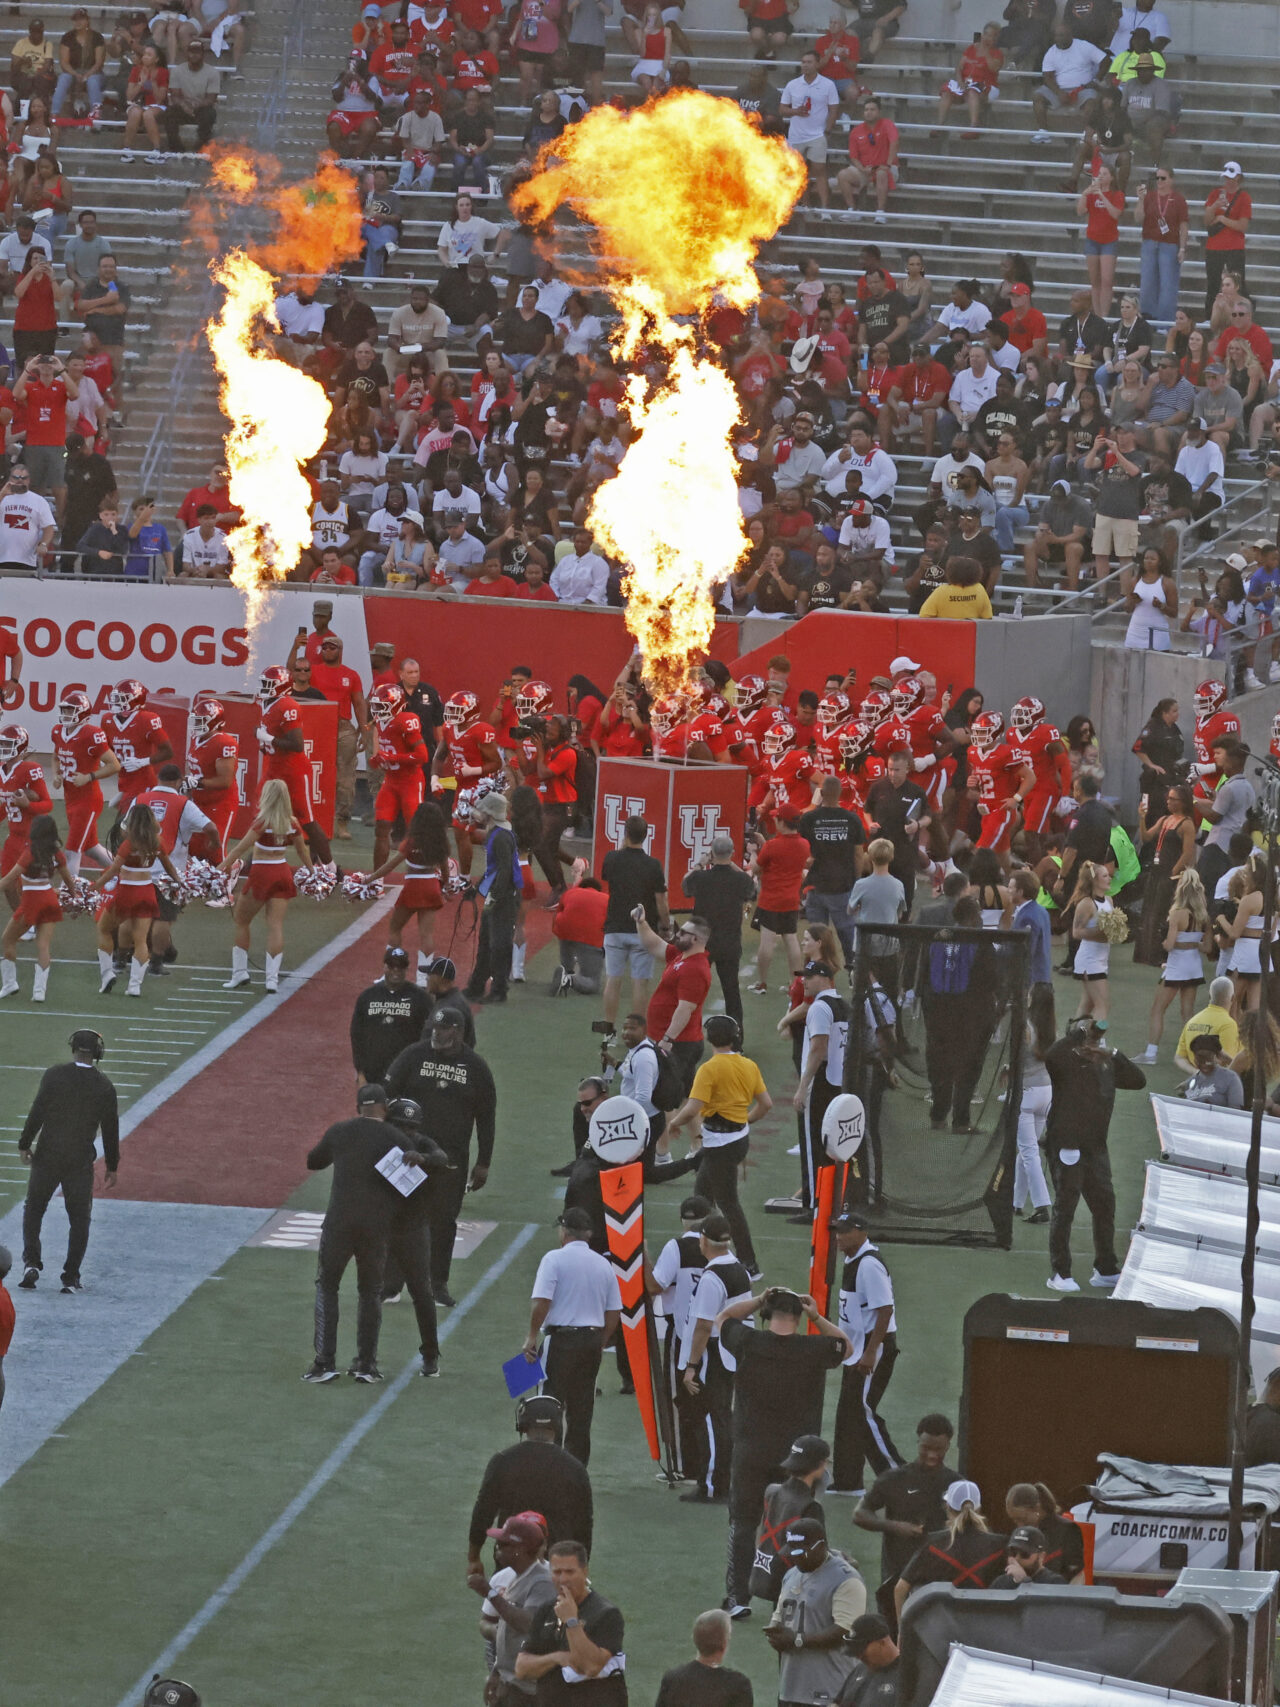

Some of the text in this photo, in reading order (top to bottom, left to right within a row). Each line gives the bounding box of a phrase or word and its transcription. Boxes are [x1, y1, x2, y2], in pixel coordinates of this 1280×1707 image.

[986, 412, 1016, 425] COLORADO
[321, 530, 338, 543] 34
[949, 594, 977, 603] SECURITY
[283, 709, 298, 721] 49
[772, 711, 784, 722] 90
[406, 719, 420, 731] 30
[709, 723, 722, 735] 75
[1224, 721, 1237, 732] 70
[93, 732, 107, 744] 62
[484, 732, 495, 743] 12
[691, 731, 704, 742] 97
[893, 729, 906, 740] 43
[1049, 729, 1060, 740] 13
[223, 746, 237, 758] 62
[1011, 748, 1022, 760] 12
[30, 768, 44, 781] 56
[873, 765, 881, 776] 3
[679, 805, 730, 871] UH
[815, 833, 849, 841] CREW
[370, 1001, 410, 1010] COLORADO
[368, 1008, 411, 1018] BUFFALOES
[423, 1060, 467, 1077] COLORADO
[1111, 1522, 1227, 1542] COACHCOMM.CO
